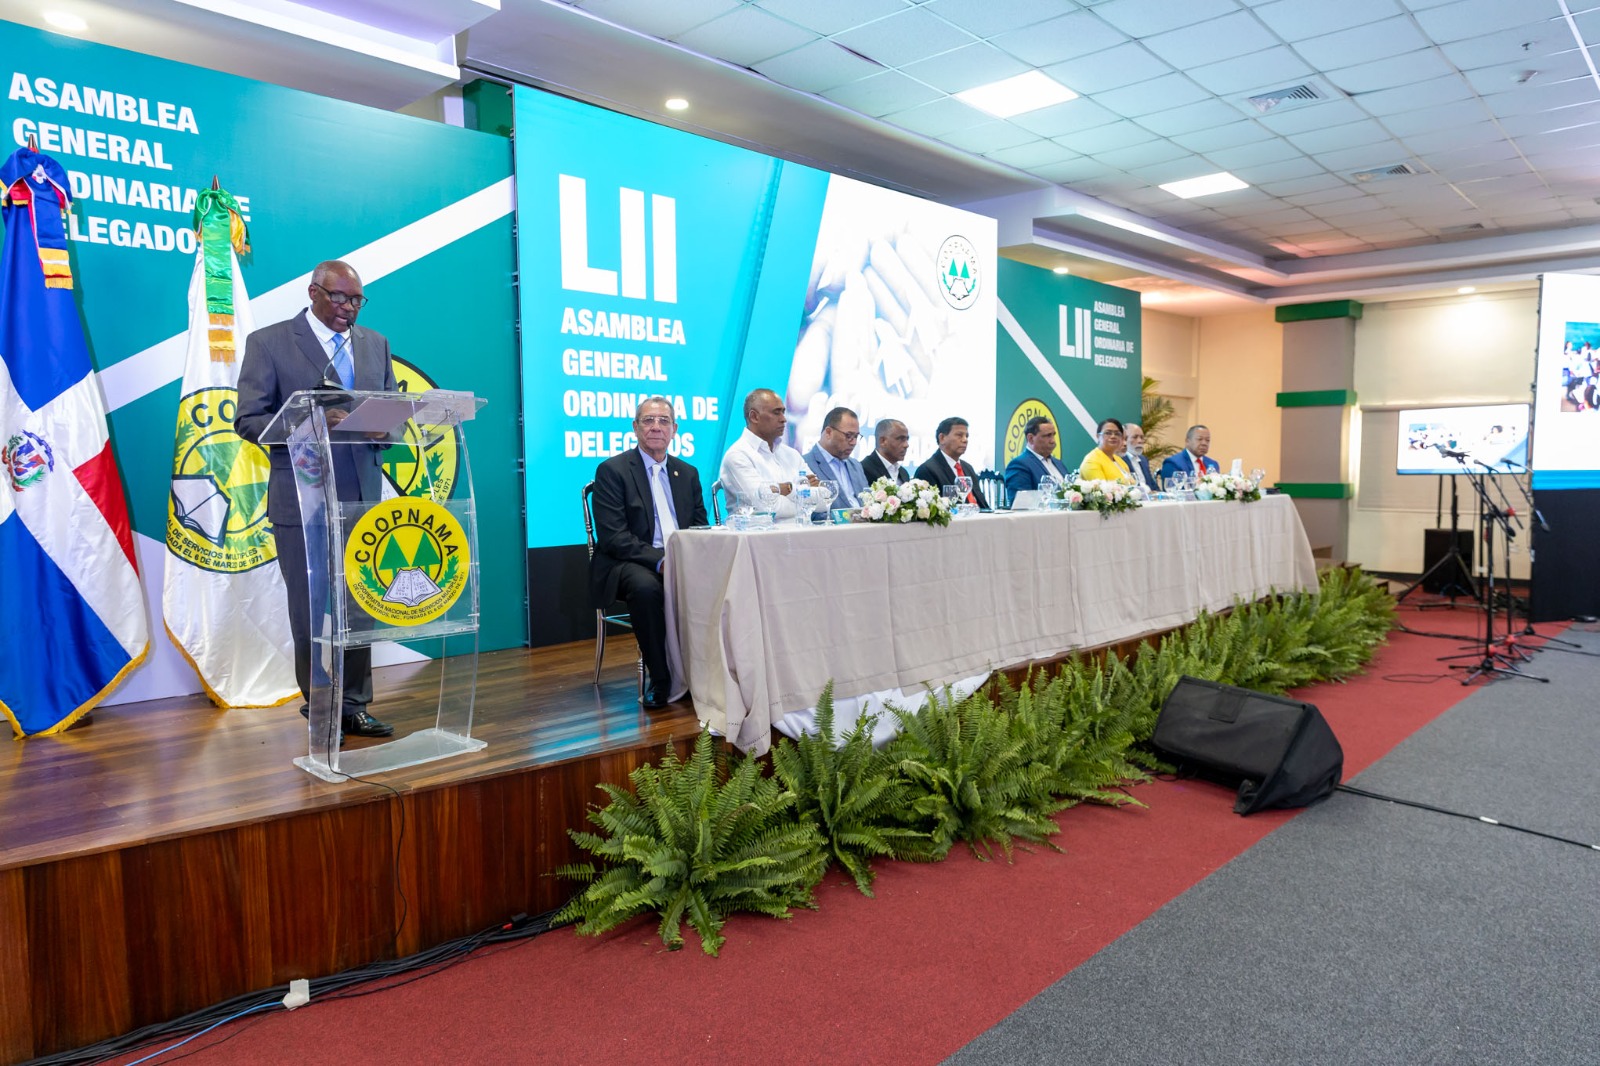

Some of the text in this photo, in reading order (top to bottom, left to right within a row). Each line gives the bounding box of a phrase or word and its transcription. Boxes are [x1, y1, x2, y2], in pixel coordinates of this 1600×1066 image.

[8, 72, 200, 135] ASAMBLEA
[12, 117, 173, 171] GENERAL
[67, 170, 198, 214] DINARIA
[558, 173, 677, 304] LII
[560, 306, 687, 345] ASAMBLEA
[1093, 301, 1126, 318] ASAMBLEA
[1058, 304, 1092, 360] LII
[1094, 318, 1121, 334] GENERAL
[1094, 336, 1134, 353] ORDINARIA DE
[562, 349, 668, 382] GENERAL
[1094, 353, 1128, 369] DELEGADOS
[563, 389, 719, 421] ORDINA DE
[564, 430, 695, 458] DELEGOS
[1008, 408, 1047, 453] COOPN
[442, 478, 452, 494] 1971
[172, 528, 183, 540] DE
[182, 537, 223, 560] SERVICIOS
[354, 508, 459, 563] COOPNAMA
[182, 548, 193, 559] EL
[194, 553, 200, 561] 6
[200, 556, 211, 566] DE
[238, 560, 248, 568] DE
[248, 554, 263, 566] 1971
[356, 590, 366, 601] LOS
[357, 581, 385, 609] COOPERATIVA
[384, 605, 410, 616] NACIONAL
